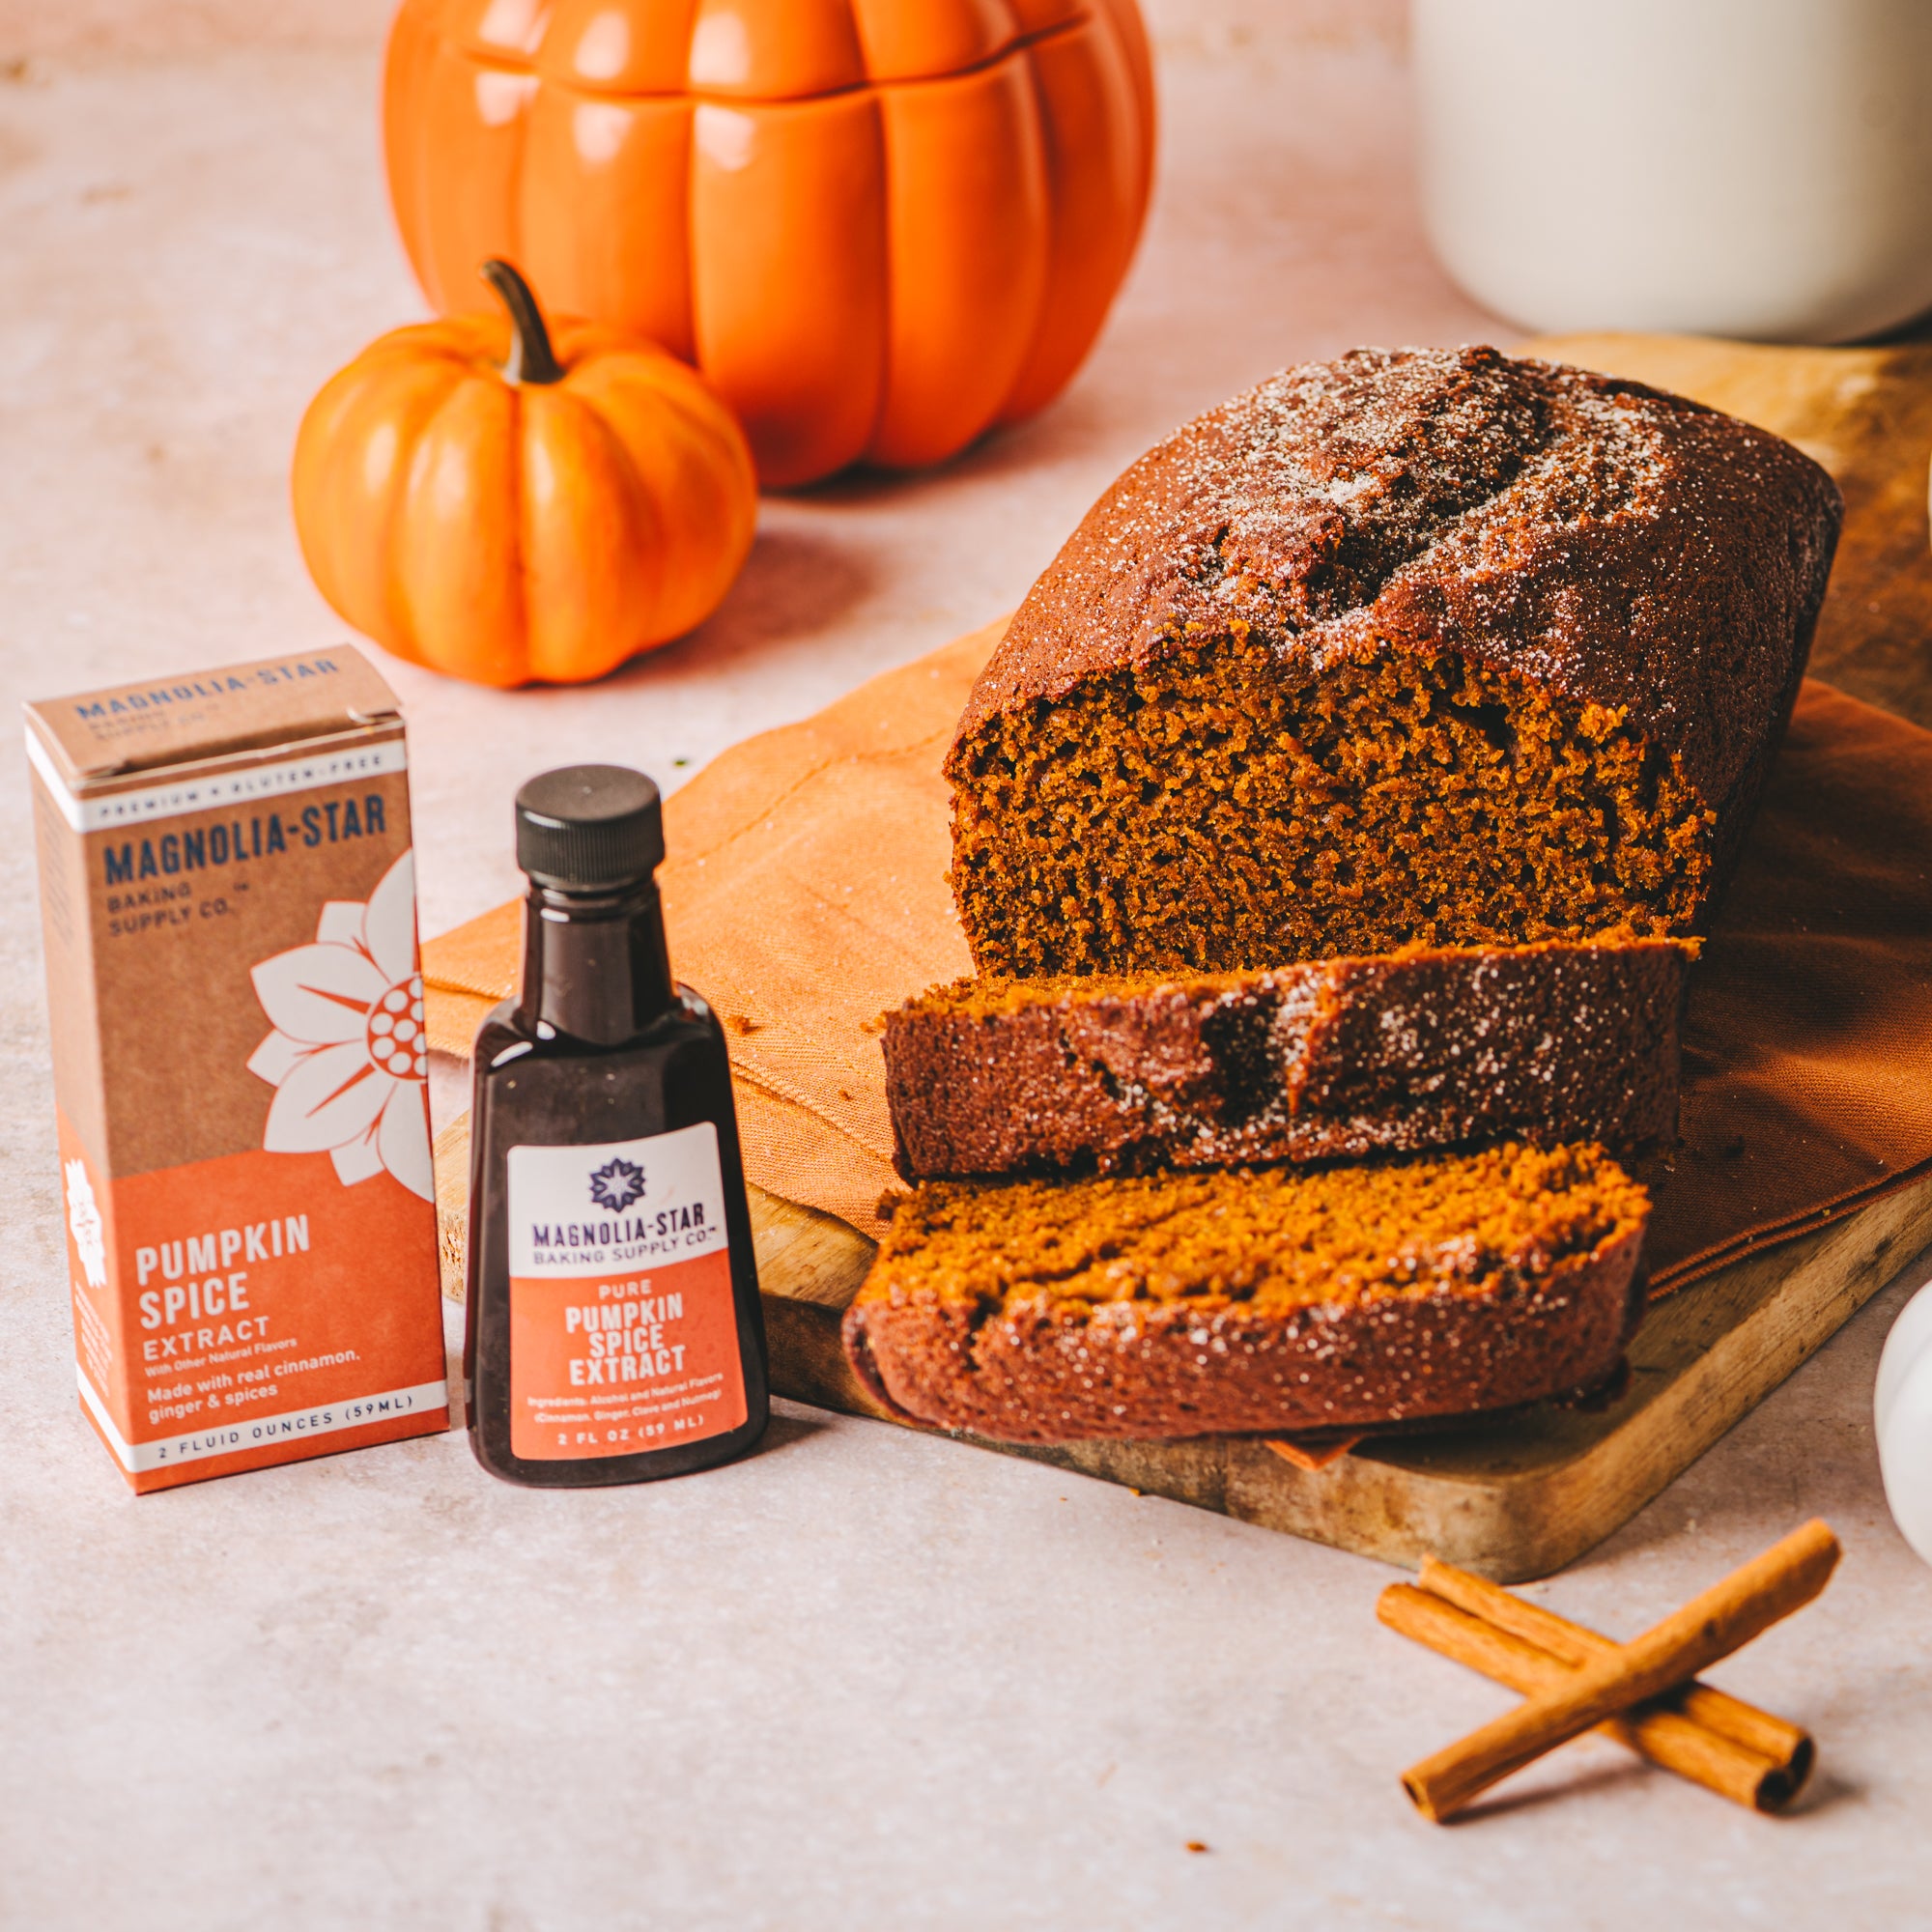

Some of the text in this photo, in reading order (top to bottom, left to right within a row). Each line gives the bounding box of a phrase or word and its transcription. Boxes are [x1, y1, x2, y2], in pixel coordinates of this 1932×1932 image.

[103, 794, 385, 886] MAGNOLIA-STAR
[107, 882, 191, 914] BAKING
[108, 904, 191, 937] SUPPLY
[533, 1202, 705, 1247] MAGNOLIA-STAR
[135, 1213, 310, 1286] PUMPKIN
[533, 1250, 606, 1264] BAKING
[612, 1236, 679, 1262] SUPPLY
[139, 1271, 250, 1330] SPICE
[598, 1278, 652, 1300] PURE
[565, 1292, 683, 1333] PUMPKIN
[143, 1316, 270, 1361] EXTRACT
[145, 1338, 298, 1378] With Other Natural Flavors
[588, 1323, 665, 1358] SPICE
[147, 1382, 193, 1404] Made
[196, 1374, 233, 1394] with
[237, 1364, 270, 1383] real
[569, 1345, 686, 1385] EXTRACT
[148, 1383, 279, 1425] ginger & spices
[630, 1389, 650, 1401] and
[651, 1381, 689, 1397] Natural
[689, 1373, 724, 1388] Flavors
[159, 1395, 413, 1459] 2 FLUID OUNCES (59ML)
[632, 1405, 661, 1416] Clove
[661, 1399, 682, 1411] and
[557, 1414, 704, 1446] 2 FL OZ (59 ML)
